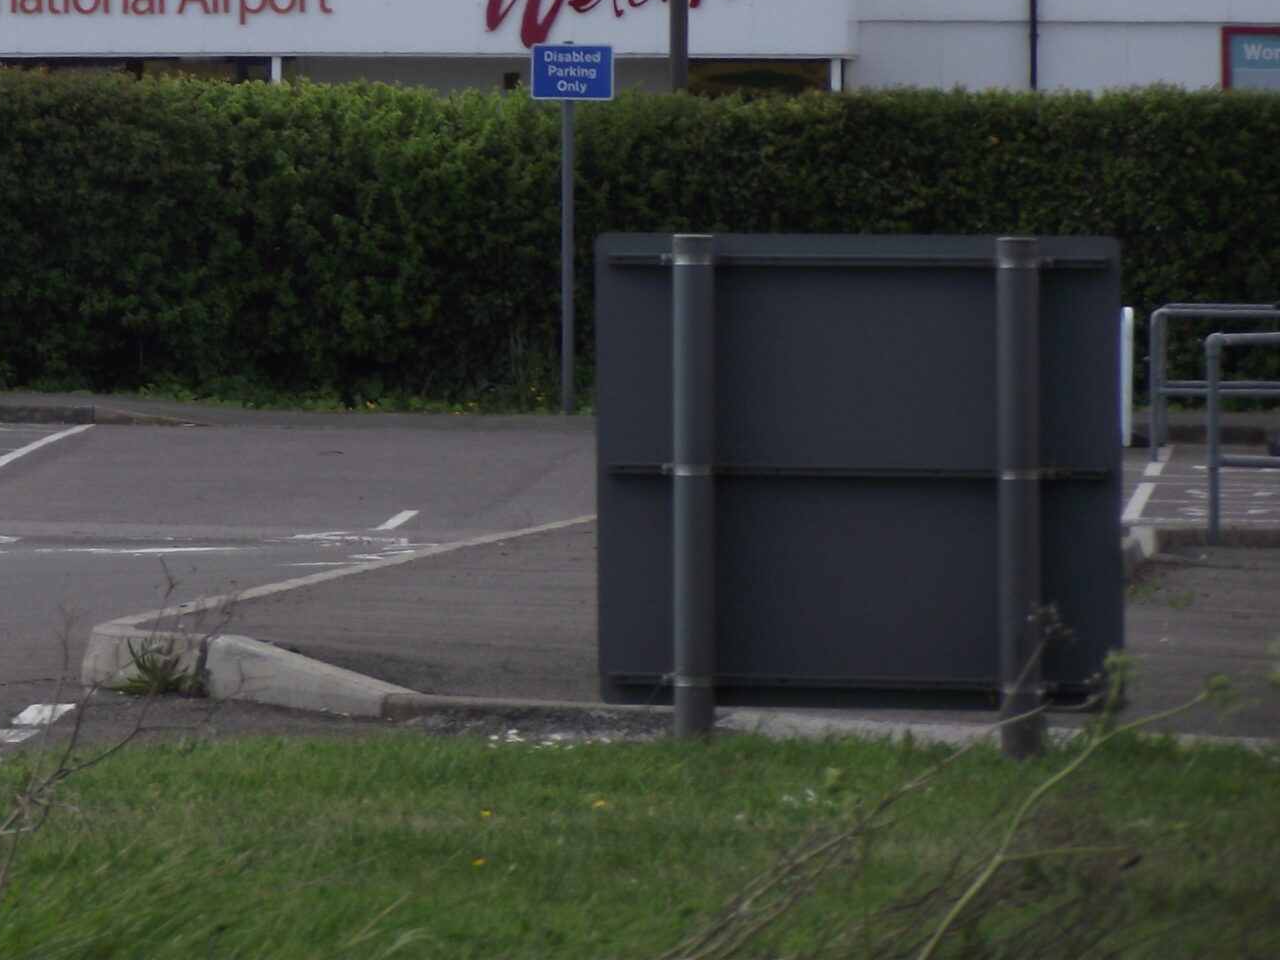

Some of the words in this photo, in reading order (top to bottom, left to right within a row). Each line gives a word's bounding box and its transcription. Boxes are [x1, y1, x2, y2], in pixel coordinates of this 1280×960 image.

[544, 50, 601, 63] Disabled
[548, 64, 597, 79] Parking
[557, 80, 587, 93] Only
